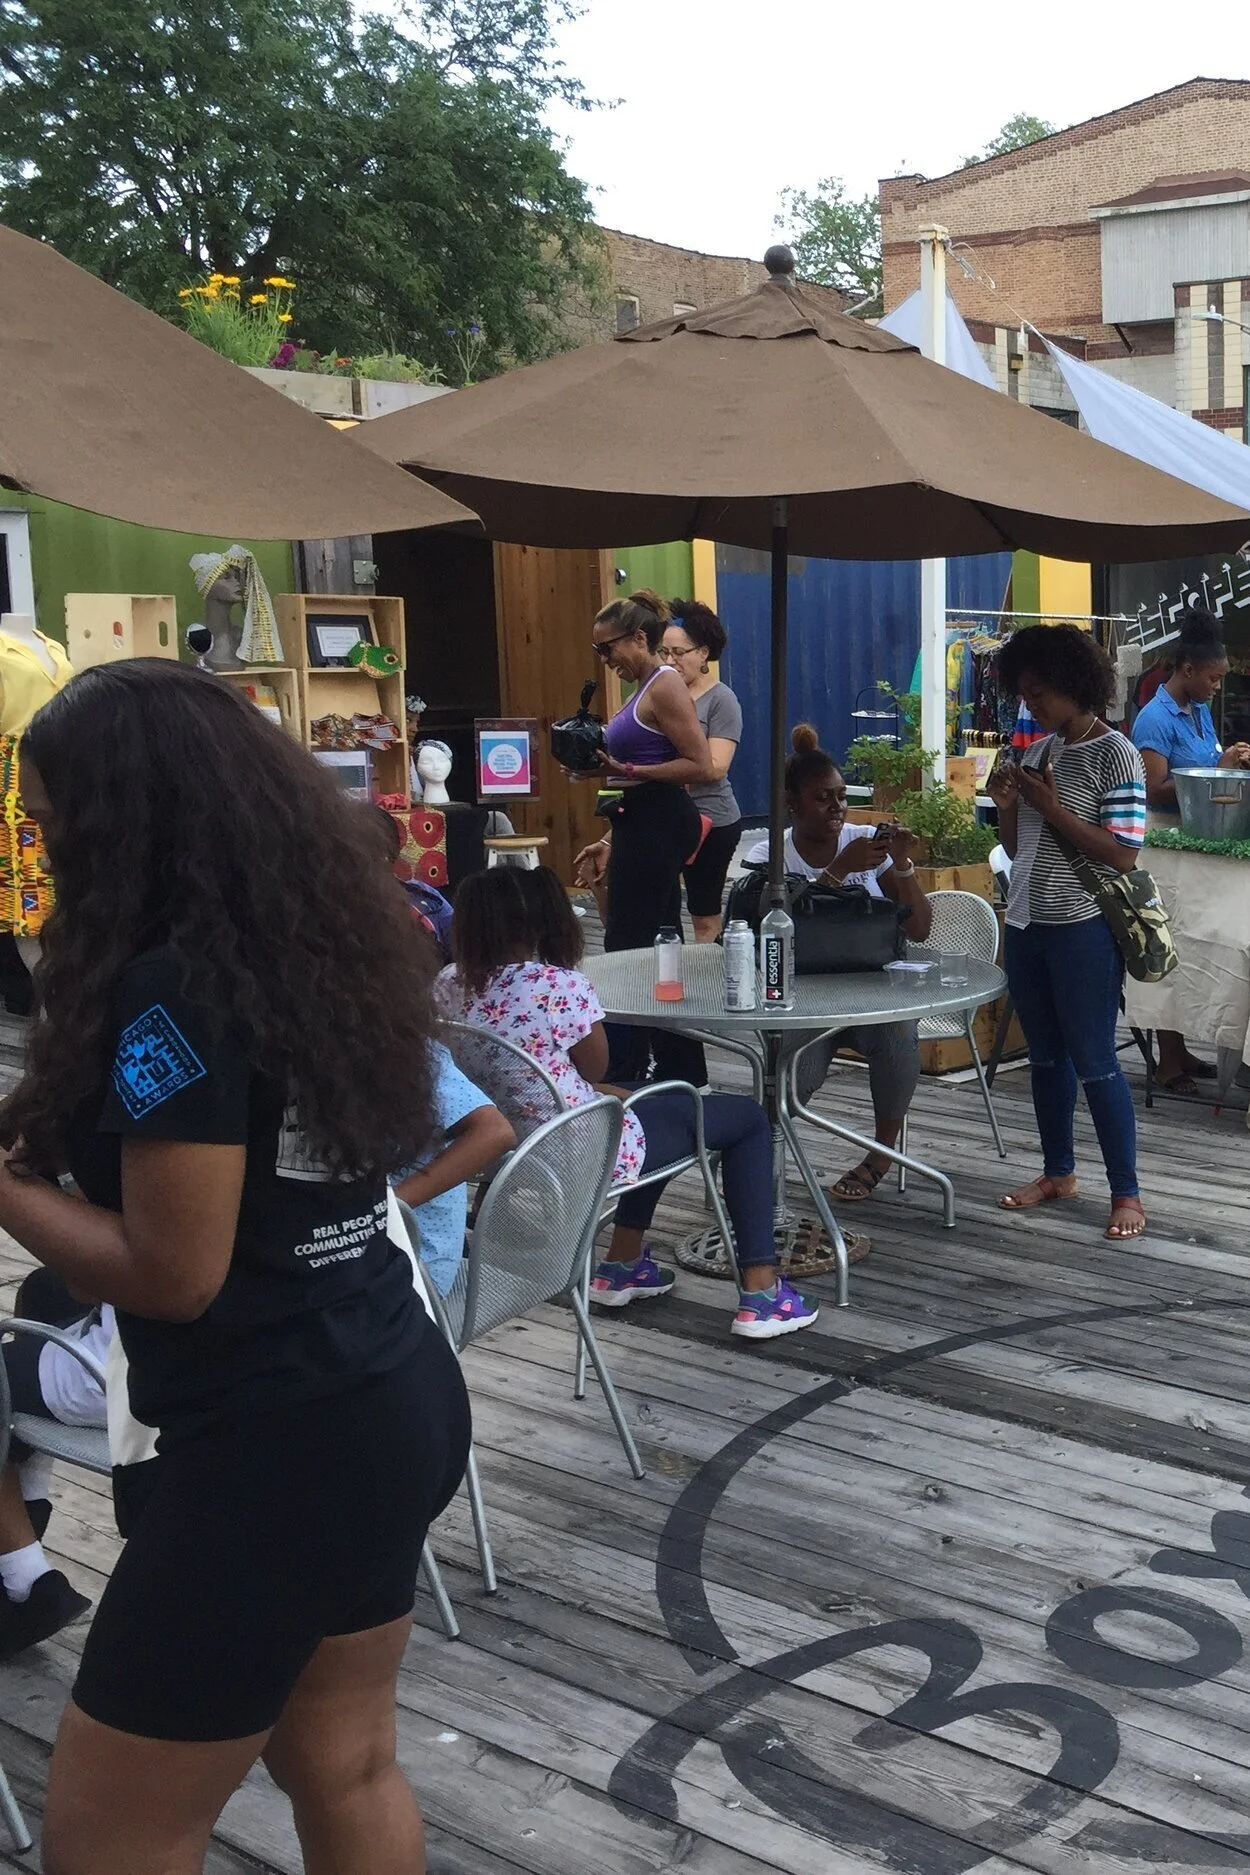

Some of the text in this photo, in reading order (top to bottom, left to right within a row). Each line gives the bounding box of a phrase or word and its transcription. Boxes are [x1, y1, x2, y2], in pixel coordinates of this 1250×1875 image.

[768, 940, 779, 985] essentia
[145, 1071, 189, 1105] AWARDS
[313, 1224, 340, 1240] REAL
[342, 1214, 373, 1233] PEOP
